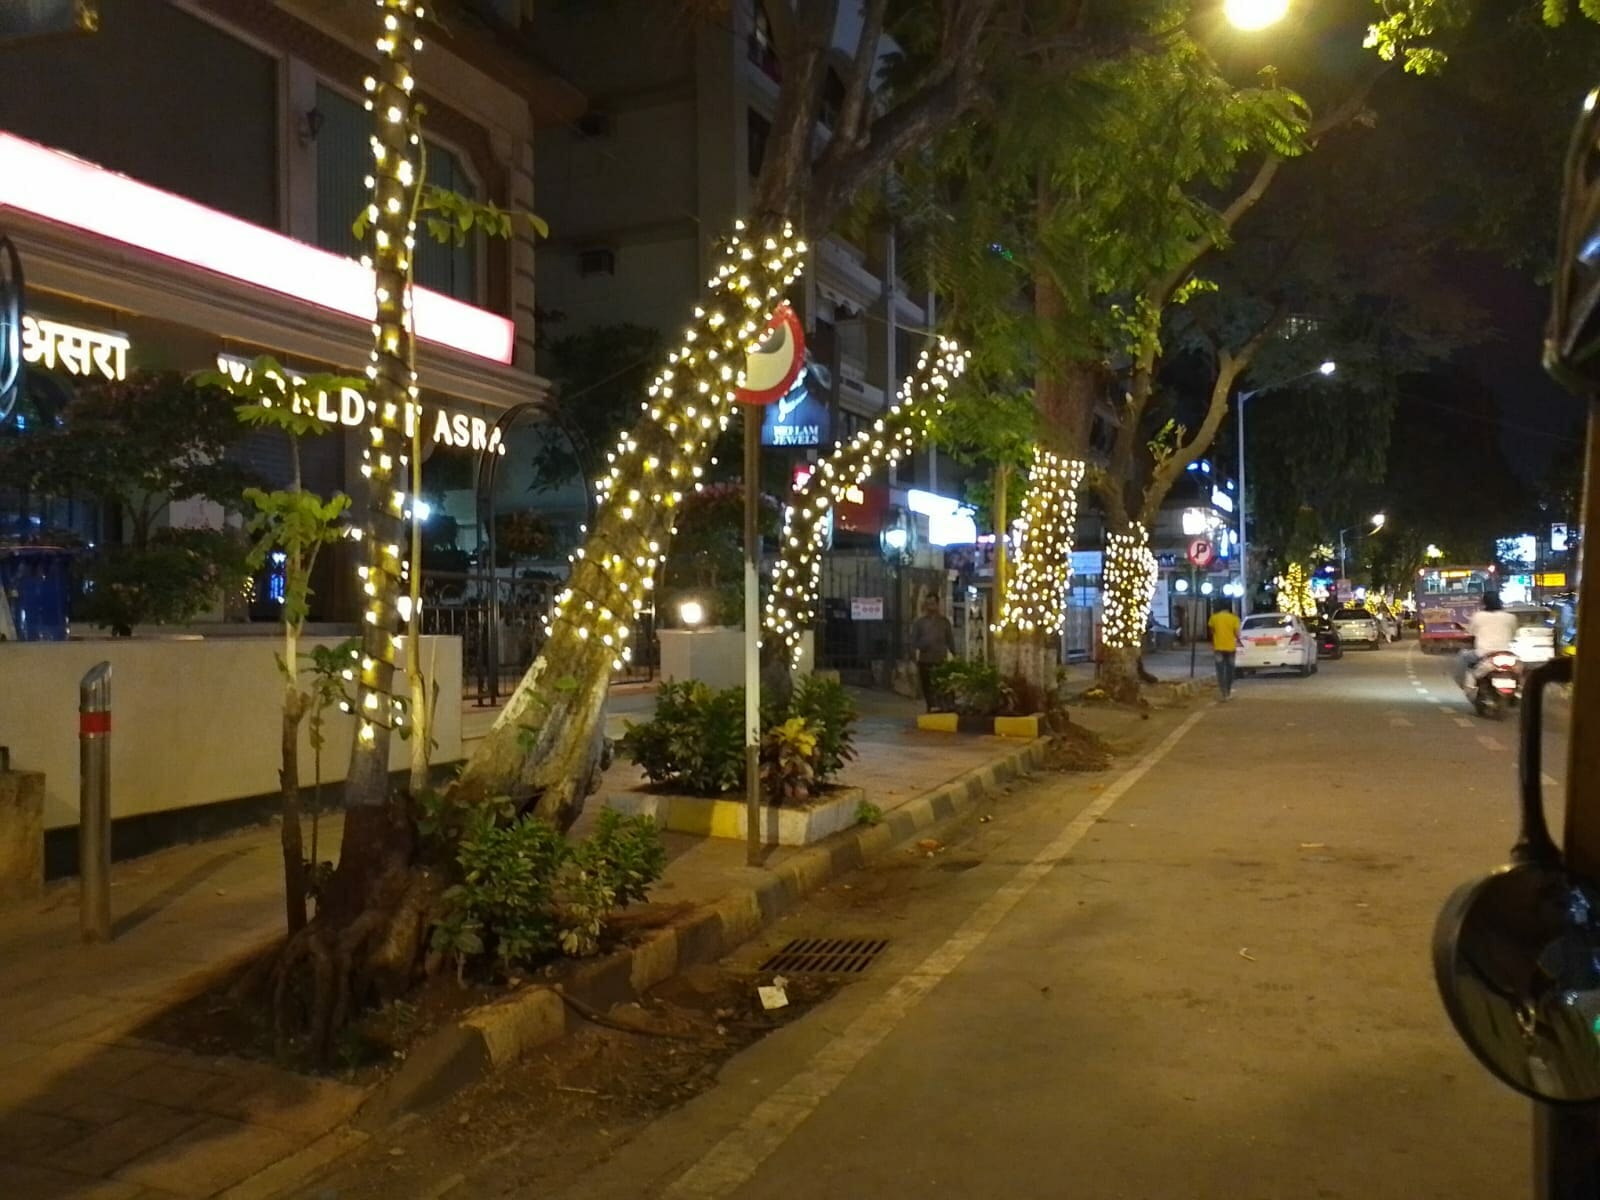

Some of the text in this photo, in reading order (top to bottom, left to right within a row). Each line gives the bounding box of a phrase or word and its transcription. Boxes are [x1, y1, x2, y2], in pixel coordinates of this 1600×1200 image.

[22, 315, 130, 381] असरा
[433, 410, 506, 456] ASRA
[772, 435, 819, 446] JEWELS
